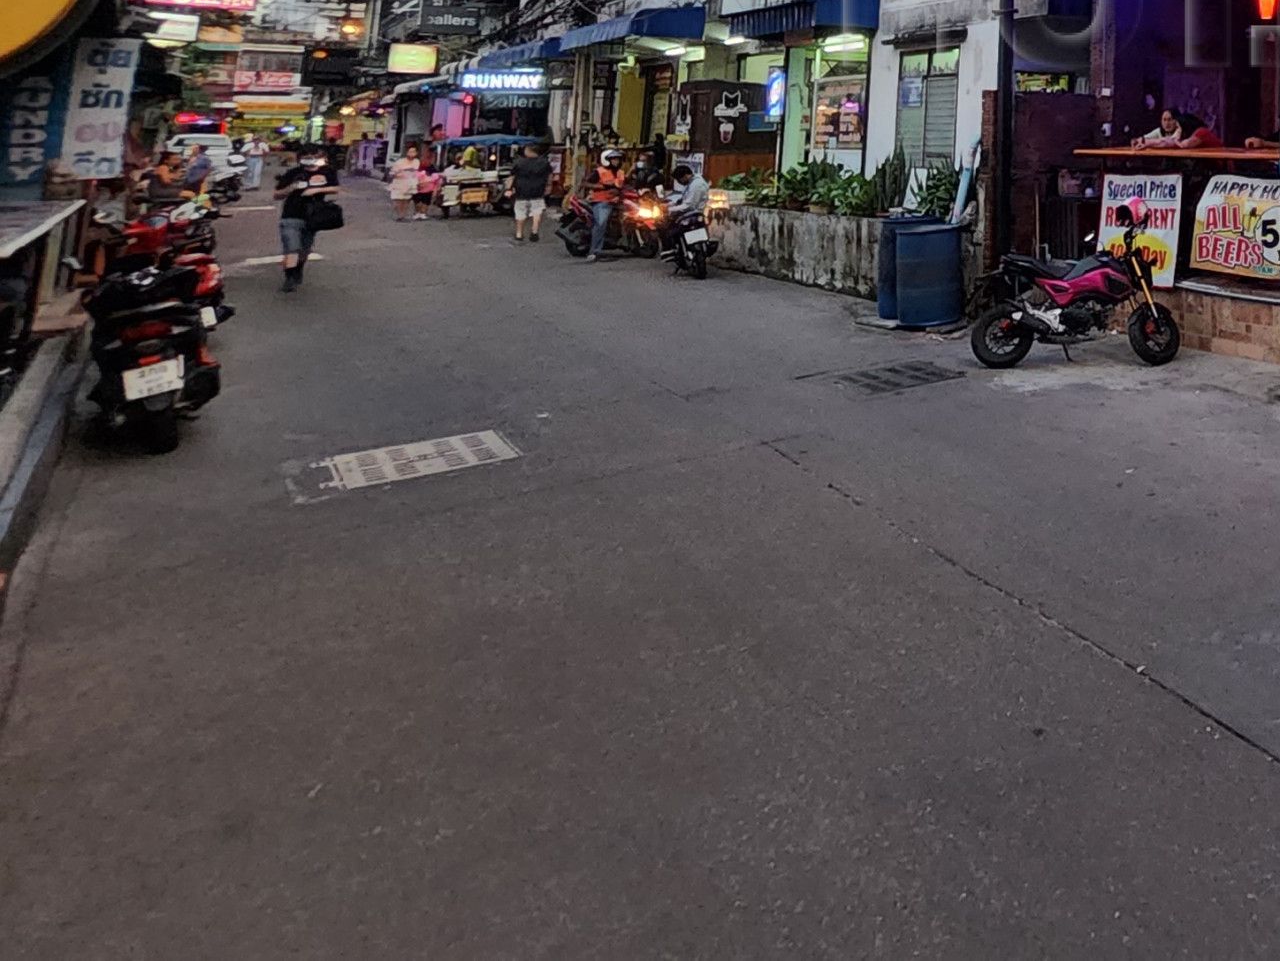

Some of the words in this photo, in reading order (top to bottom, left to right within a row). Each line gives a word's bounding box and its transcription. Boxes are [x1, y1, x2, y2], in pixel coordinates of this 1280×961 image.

[462, 74, 542, 89] RUNWAY
[8, 76, 54, 181] AUNDRY
[1107, 180, 1147, 199] Special
[1149, 181, 1177, 199] Price
[1211, 181, 1260, 200] HAPPY
[1204, 204, 1242, 233] ALL
[1197, 235, 1264, 267] BEERS
